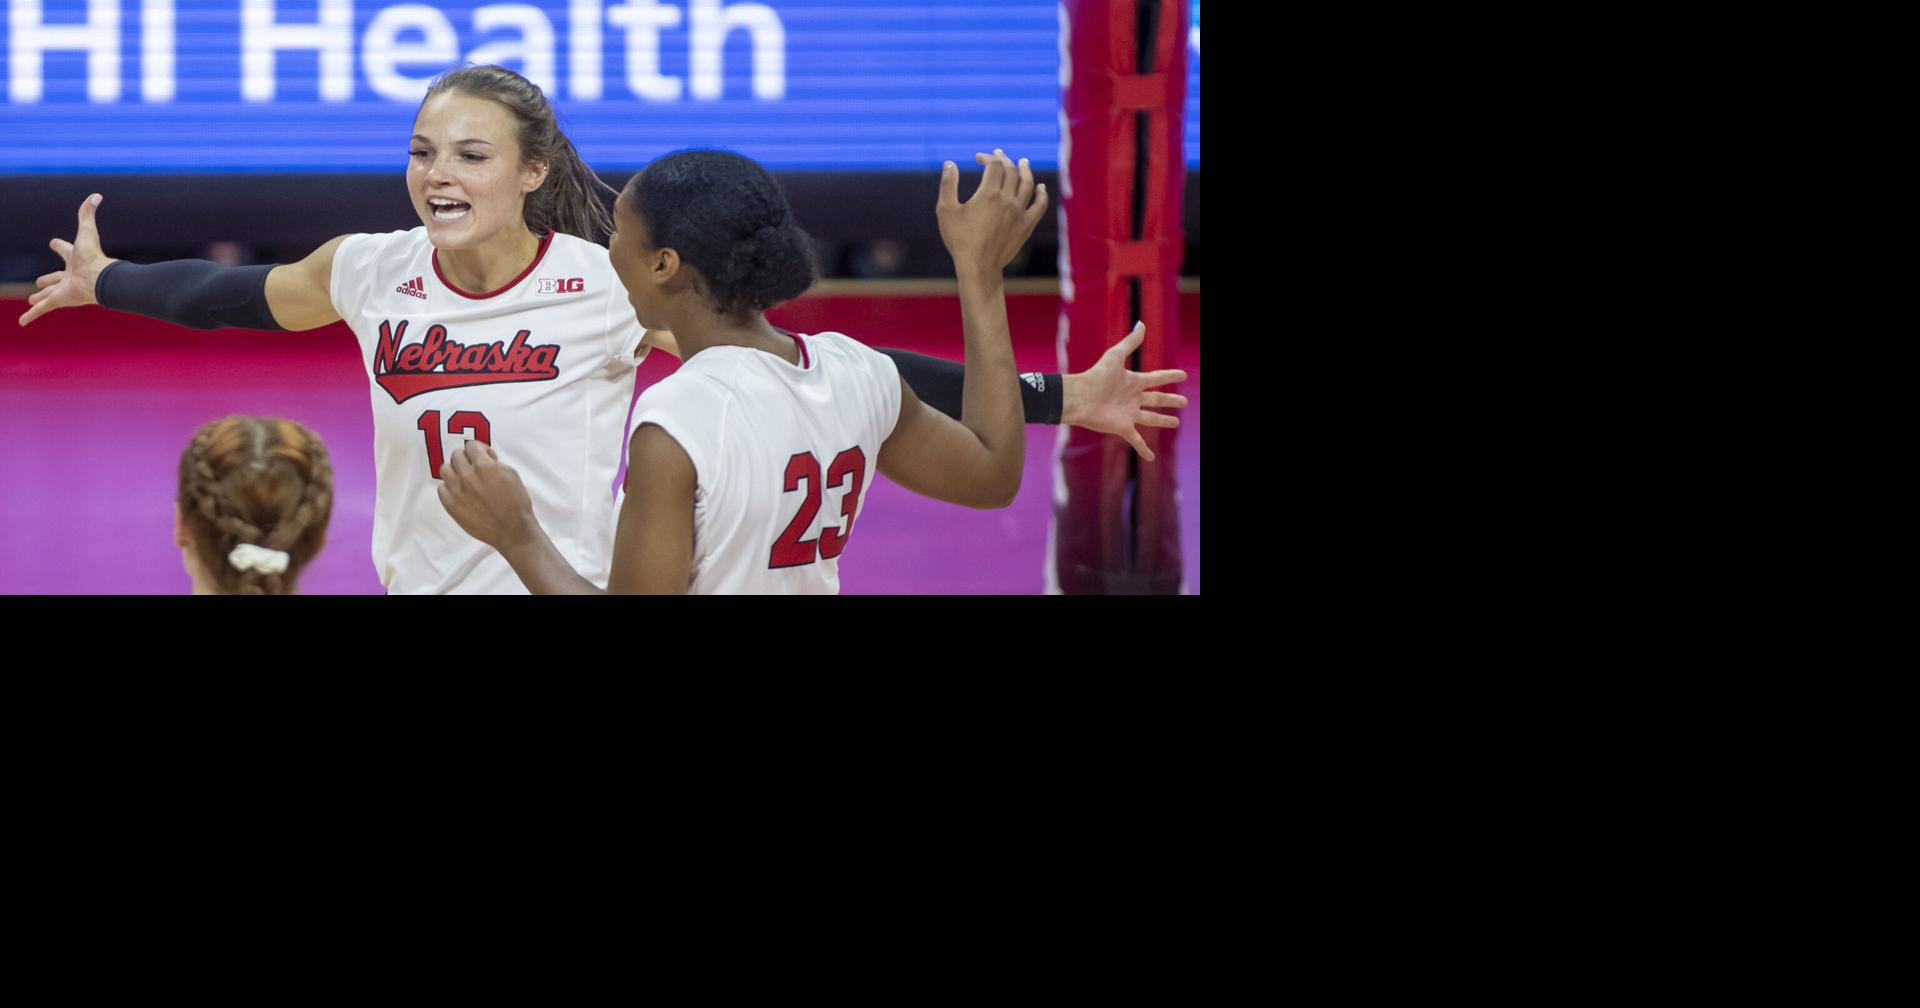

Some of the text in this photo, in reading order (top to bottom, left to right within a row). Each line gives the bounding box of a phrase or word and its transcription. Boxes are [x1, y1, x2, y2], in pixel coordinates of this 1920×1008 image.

[240, 0, 787, 102] Health
[396, 285, 428, 300] adidas
[374, 320, 561, 378] Nebraska
[768, 445, 866, 569] 23
